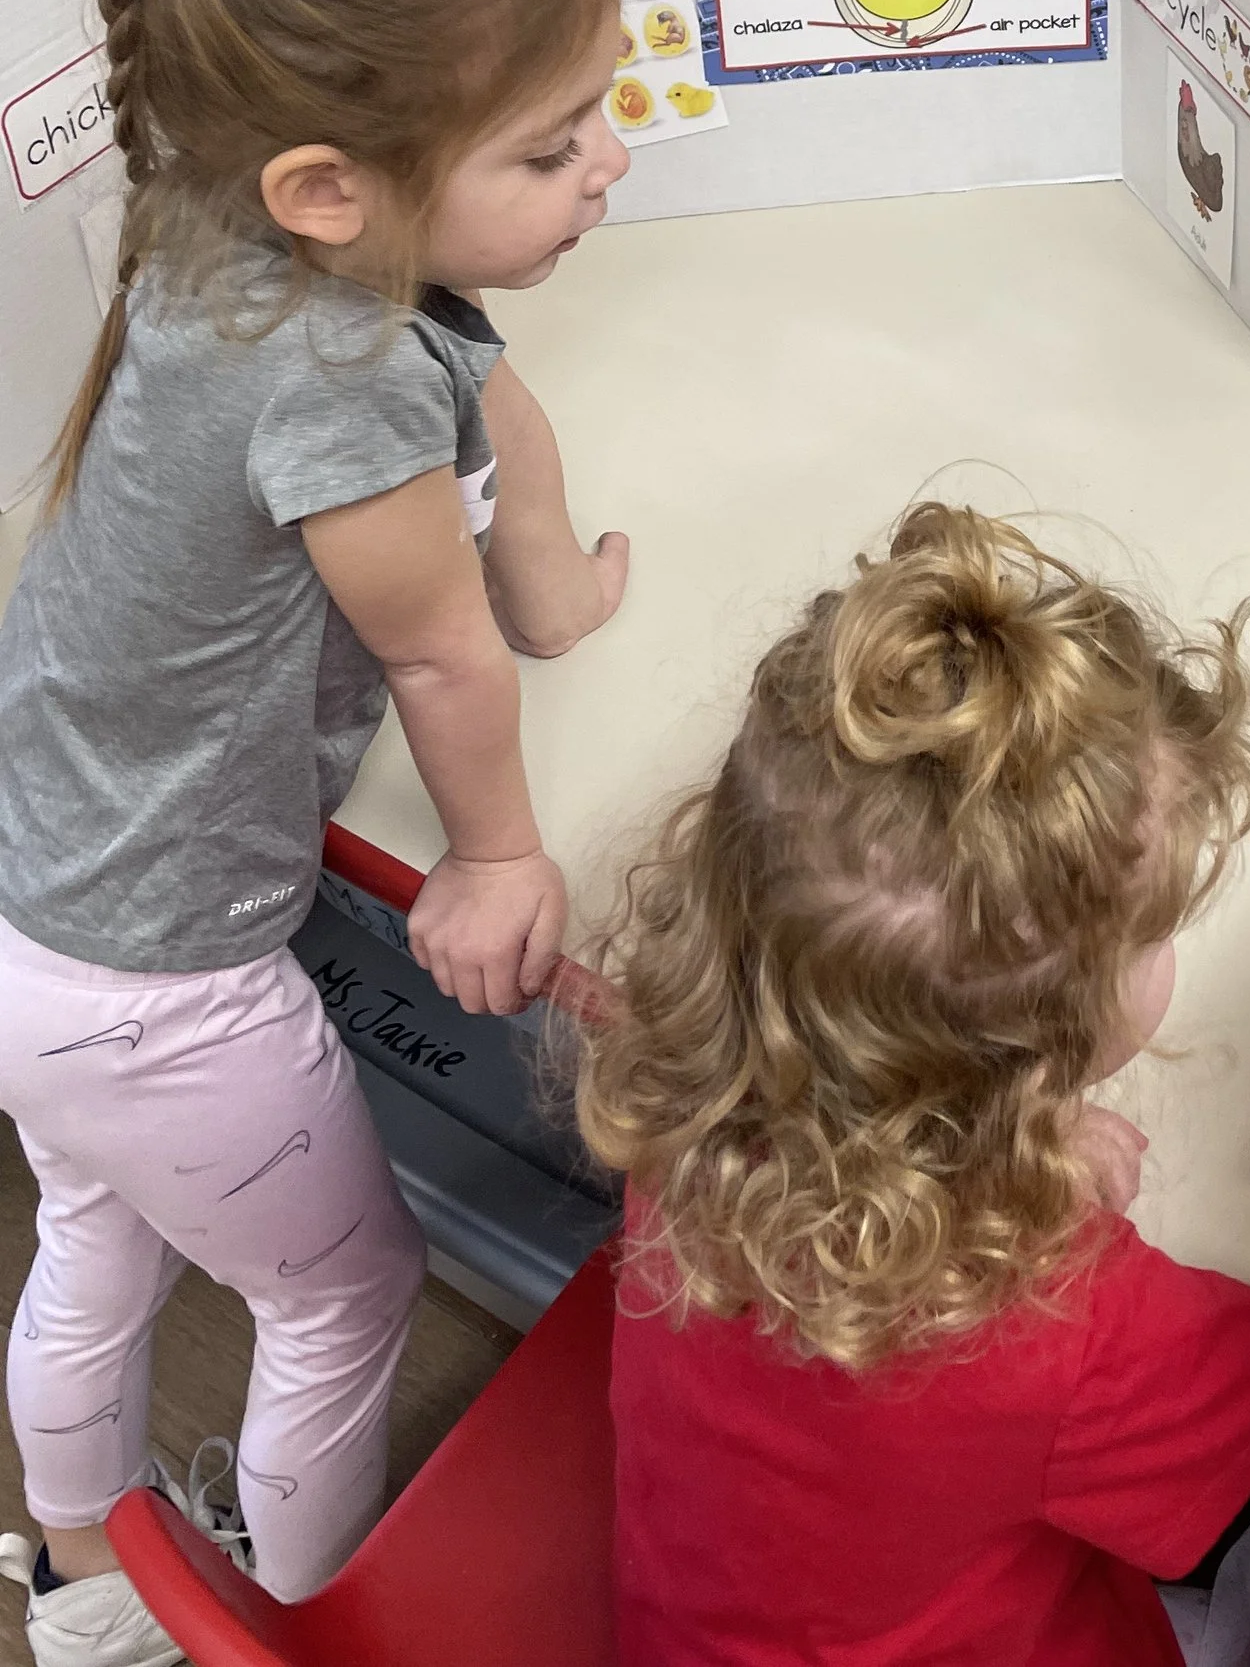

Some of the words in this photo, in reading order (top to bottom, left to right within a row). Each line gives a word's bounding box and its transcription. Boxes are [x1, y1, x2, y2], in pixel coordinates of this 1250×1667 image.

[734, 18, 803, 35] chalaza
[990, 18, 1014, 31] air
[1019, 14, 1081, 33] pocket
[27, 83, 116, 165] chick
[228, 886, 296, 916] DRI-FIT
[311, 959, 363, 1014] Ms.
[347, 989, 467, 1077] Jackie
